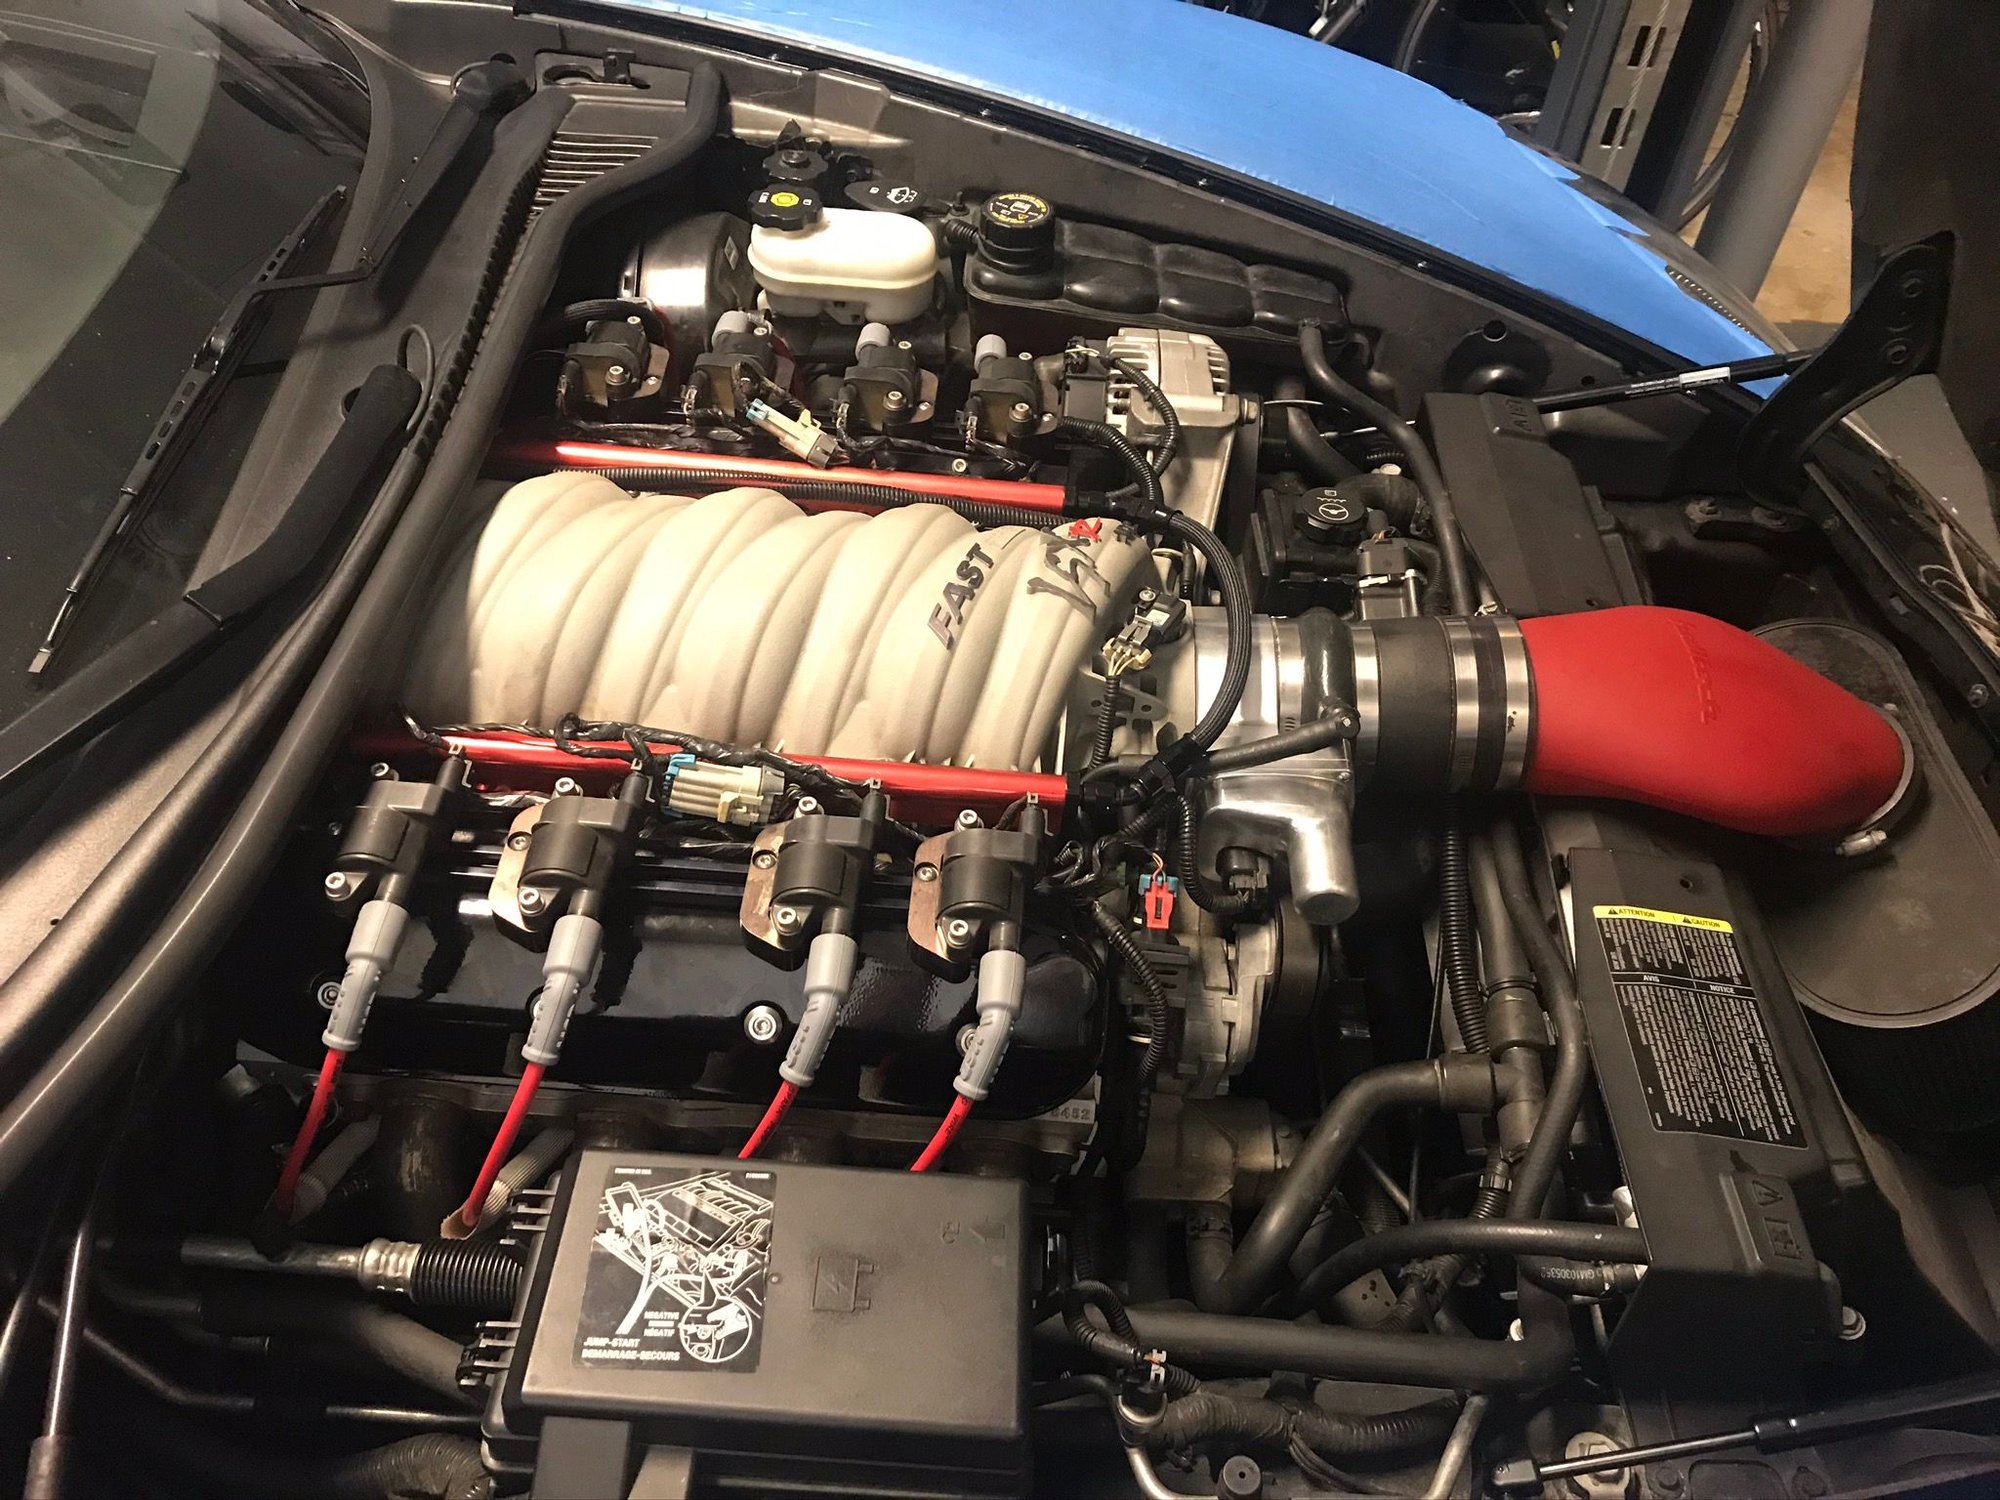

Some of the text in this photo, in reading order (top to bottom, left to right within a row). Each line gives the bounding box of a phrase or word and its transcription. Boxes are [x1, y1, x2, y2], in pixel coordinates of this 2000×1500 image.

[927, 542, 995, 650] FAST
[1619, 908, 1656, 918] ATTENTION
[1691, 918, 1721, 928] CAUTION
[1643, 974, 1660, 983] AVIS
[1709, 984, 1736, 994] NOTICE
[643, 1311, 680, 1320] NEGATIVE
[583, 1337, 641, 1348] JUMP-START
